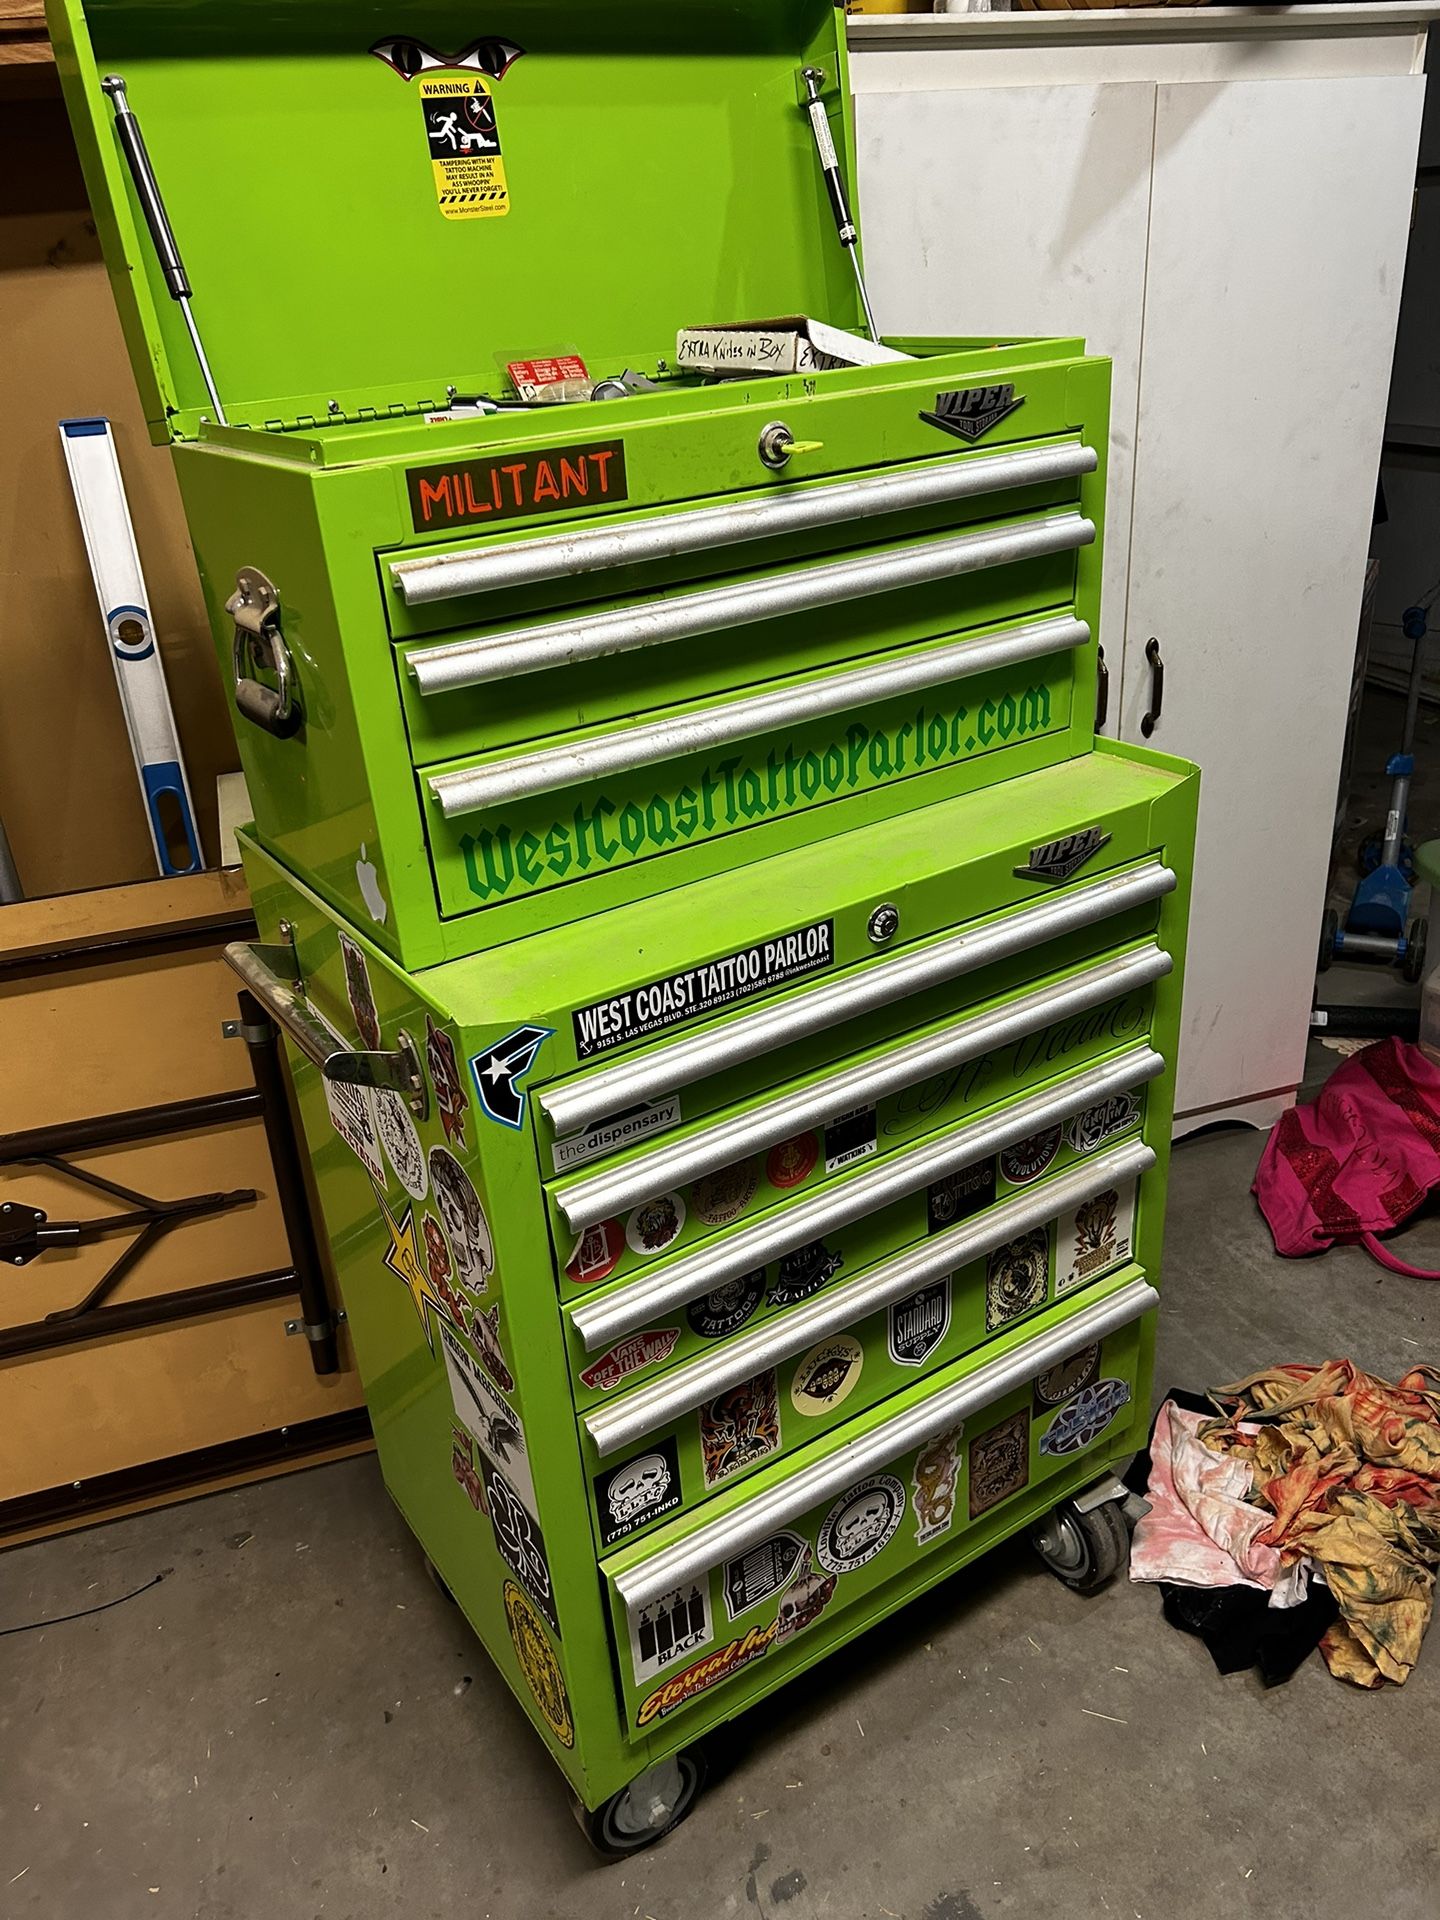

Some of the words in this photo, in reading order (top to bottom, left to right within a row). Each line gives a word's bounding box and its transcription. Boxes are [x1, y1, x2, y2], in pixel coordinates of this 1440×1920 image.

[423, 83, 470, 95] WARNING
[439, 159, 471, 167] TAMPERING
[442, 187, 462, 195] YOU'LL
[462, 186, 480, 194] NEVER
[463, 179, 491, 187] WHOOPIN'
[445, 204, 506, 215] www.MonsterSteel.com
[678, 338, 710, 361] EXTRA
[937, 384, 1014, 416] VIPER
[960, 419, 974, 433] TOOL
[975, 411, 998, 432] STORAGE
[419, 451, 613, 522] MILITANT
[459, 682, 1051, 900] WestCoastTattooParlor.com
[1029, 826, 1101, 869] VIPER
[578, 995, 631, 1042] WEST
[636, 972, 695, 1021] COAST
[698, 949, 760, 998] TATTOO
[765, 924, 829, 974] PARLOR
[597, 1036, 616, 1049] 9151
[625, 1026, 639, 1038] LAS
[639, 1017, 663, 1033] VEGAS
[663, 1011, 684, 1023] BLVD.
[713, 990, 735, 1004] 89123
[785, 954, 830, 977] @inkwestcoast
[331, 1112, 386, 1187] SPECTATOR
[837, 1145, 867, 1165] WATKINS
[1007, 1142, 1055, 1176] REVOLUTION
[701, 1291, 757, 1330] TATTOOS
[897, 1295, 943, 1344] STANDARD
[610, 1338, 646, 1361] VANS
[898, 1325, 941, 1352] SUPPLY
[616, 1349, 643, 1372] THE
[607, 1523, 632, 1543] (775)
[634, 1497, 679, 1526] 751-INKD
[826, 1524, 896, 1572] 775-751-4653
[743, 1545, 775, 1602] STANDARD
[657, 1628, 705, 1666] BLACK
[638, 1641, 738, 1726] Eternal
[738, 1619, 779, 1657] Ink
